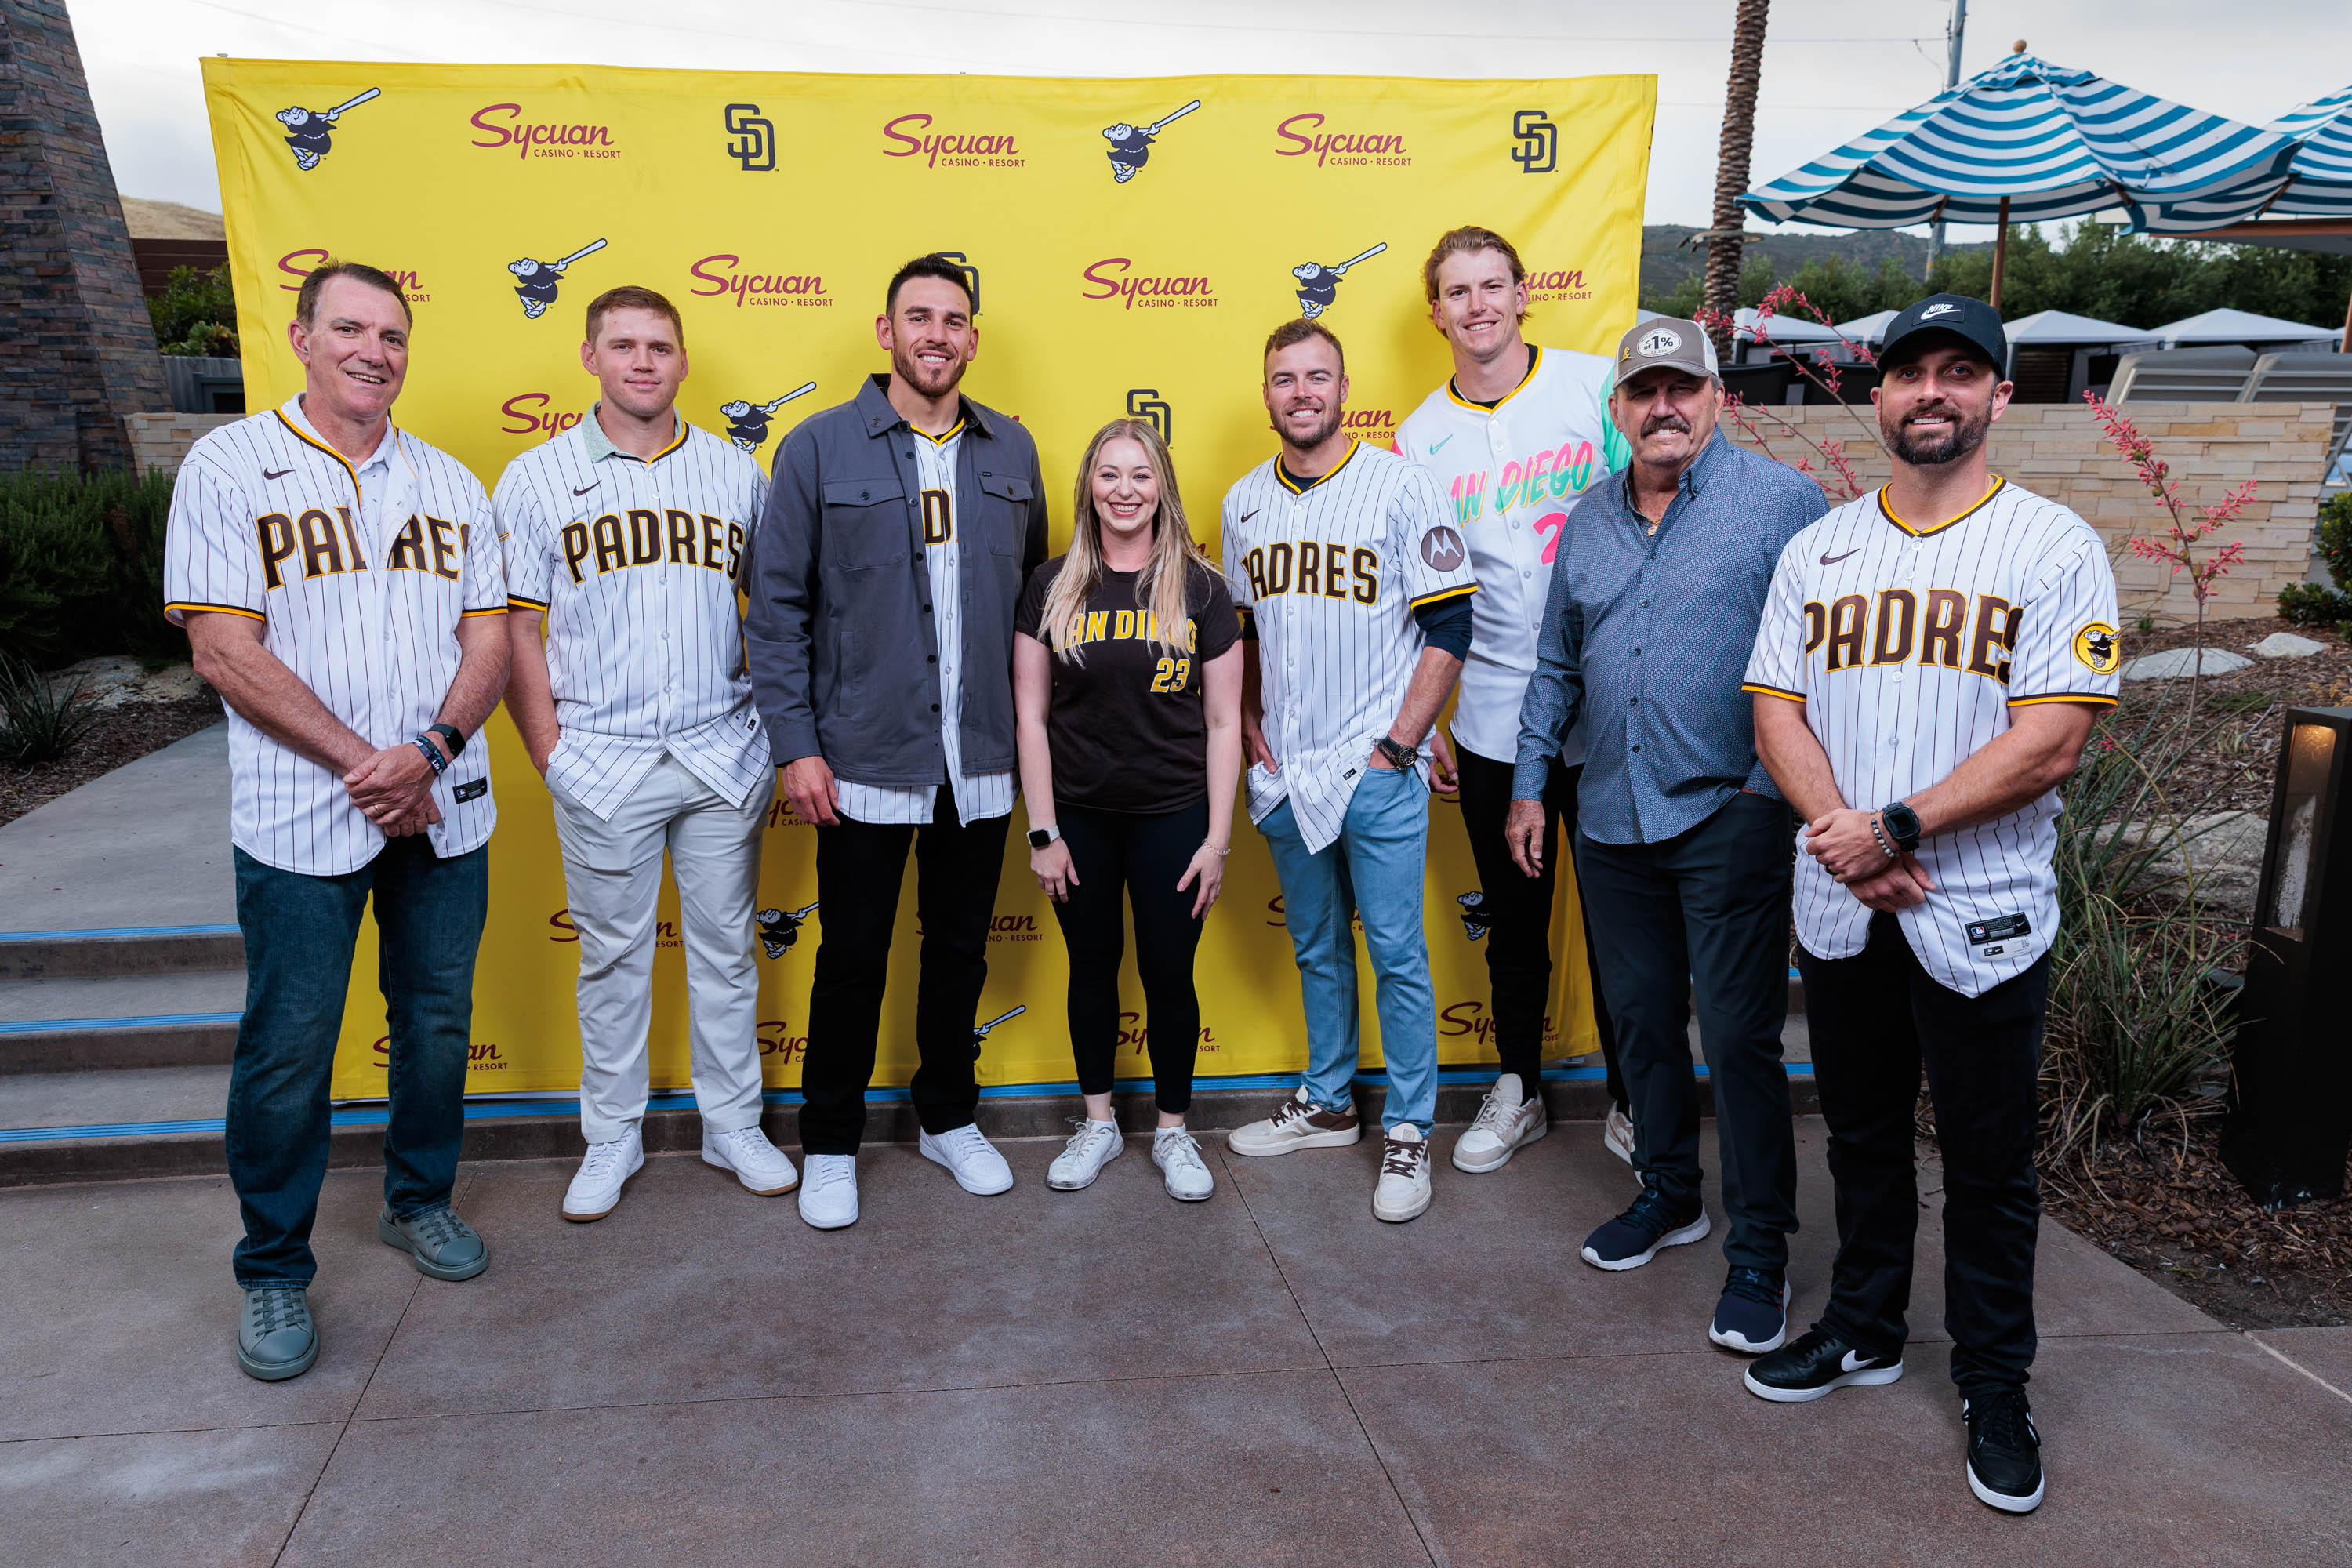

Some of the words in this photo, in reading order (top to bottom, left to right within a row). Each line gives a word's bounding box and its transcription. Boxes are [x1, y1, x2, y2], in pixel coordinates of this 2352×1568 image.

[470, 103, 615, 160] Sycuan
[883, 113, 1019, 169] Sycuan
[1275, 113, 1406, 168] Sycuan
[534, 149, 574, 158] CASINO
[584, 150, 621, 158] RESORT
[941, 158, 980, 166] CASINO
[989, 158, 1025, 167] RESORT
[1330, 157, 1367, 165] CASINO
[1376, 158, 1412, 166] RESORT
[691, 254, 827, 308] Sycuan
[1082, 257, 1213, 310] Sycuan
[1524, 270, 1587, 290] uan
[1557, 292, 1592, 301] RESORT
[750, 297, 788, 306] CASINO
[797, 298, 833, 307] RESORT
[1183, 299, 1218, 307] RESORT
[1927, 303, 1954, 313] NIKE
[502, 393, 583, 440] Syc
[1341, 409, 1396, 428] uan
[1450, 470, 1489, 528] AN
[1494, 440, 1595, 516] DIEGO
[561, 509, 745, 586] PADRES
[1053, 610, 1110, 653] AN
[1150, 657, 1191, 692] 23
[757, 1021, 808, 1065] Syc
[473, 1062, 508, 1071] RESORT
